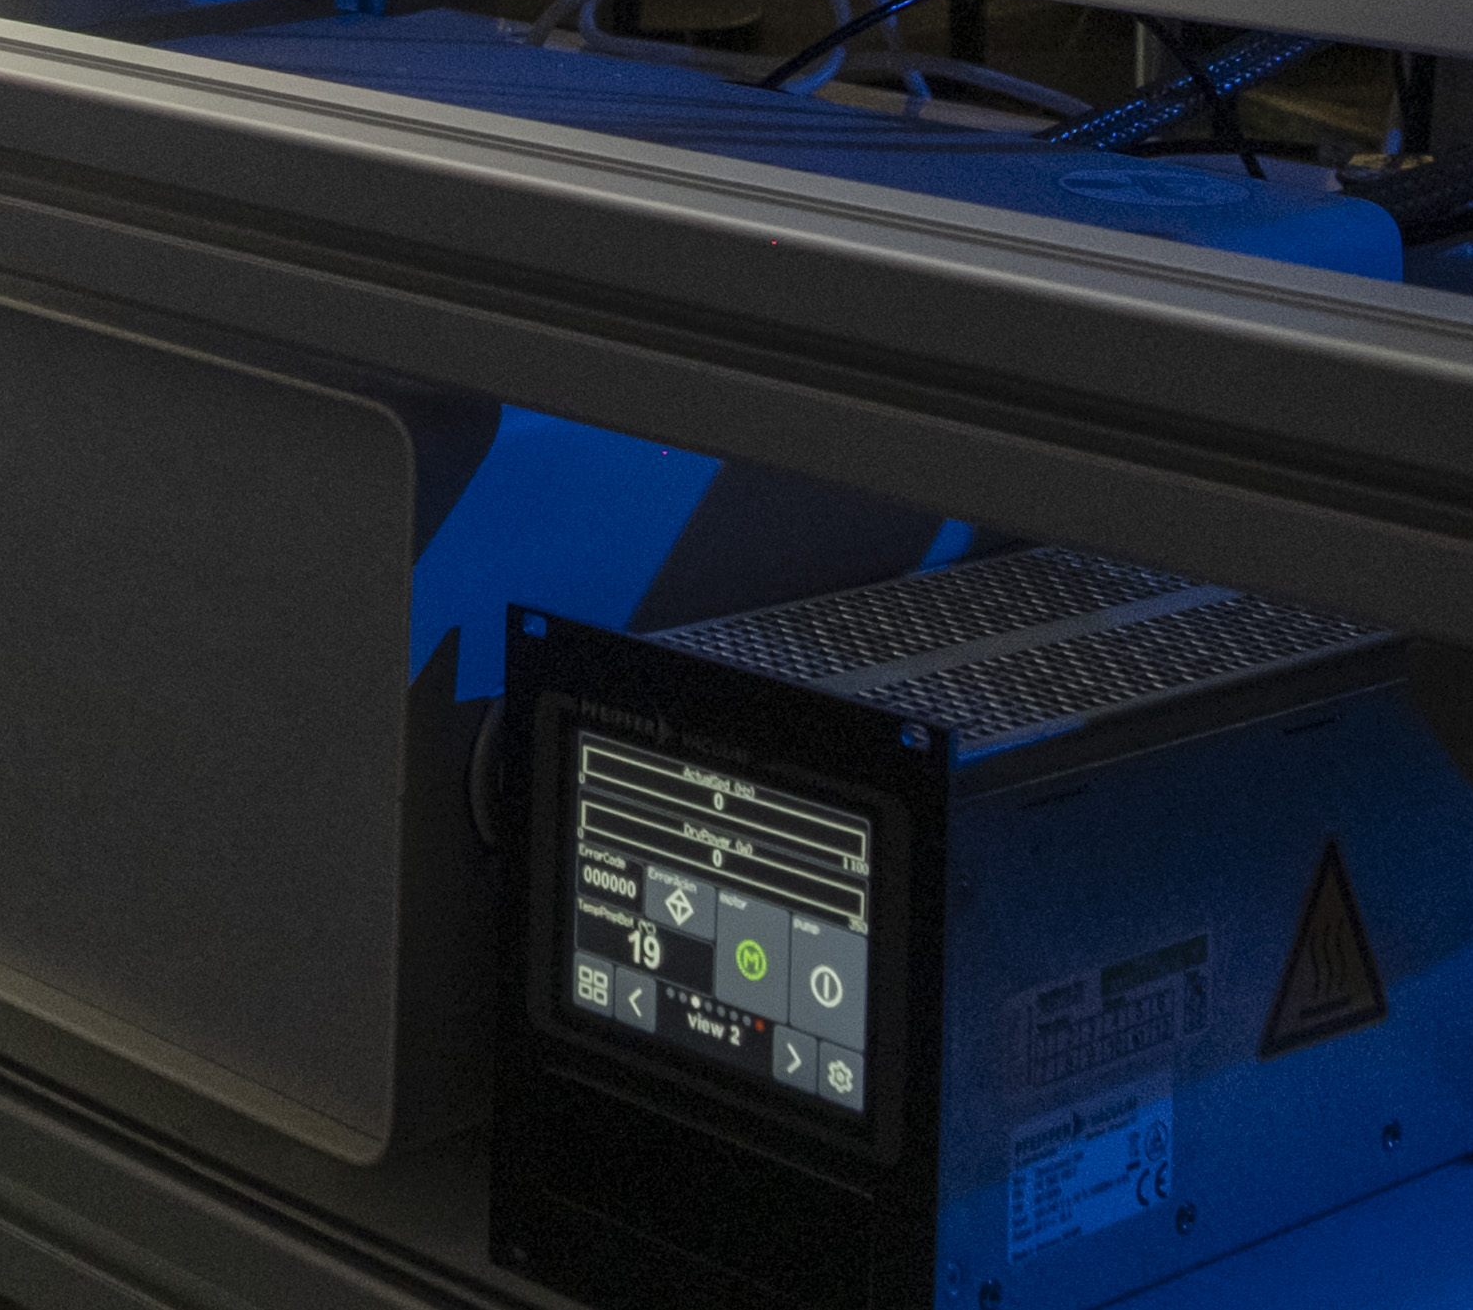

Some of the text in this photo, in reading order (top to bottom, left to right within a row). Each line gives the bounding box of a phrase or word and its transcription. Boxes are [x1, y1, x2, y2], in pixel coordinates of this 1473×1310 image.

[713, 792, 724, 811] 0
[578, 842, 626, 870] ErrorCode
[712, 849, 723, 868] 0
[582, 864, 637, 899] 000000
[627, 930, 662, 970] 19
[729, 1026, 742, 1047] 2
